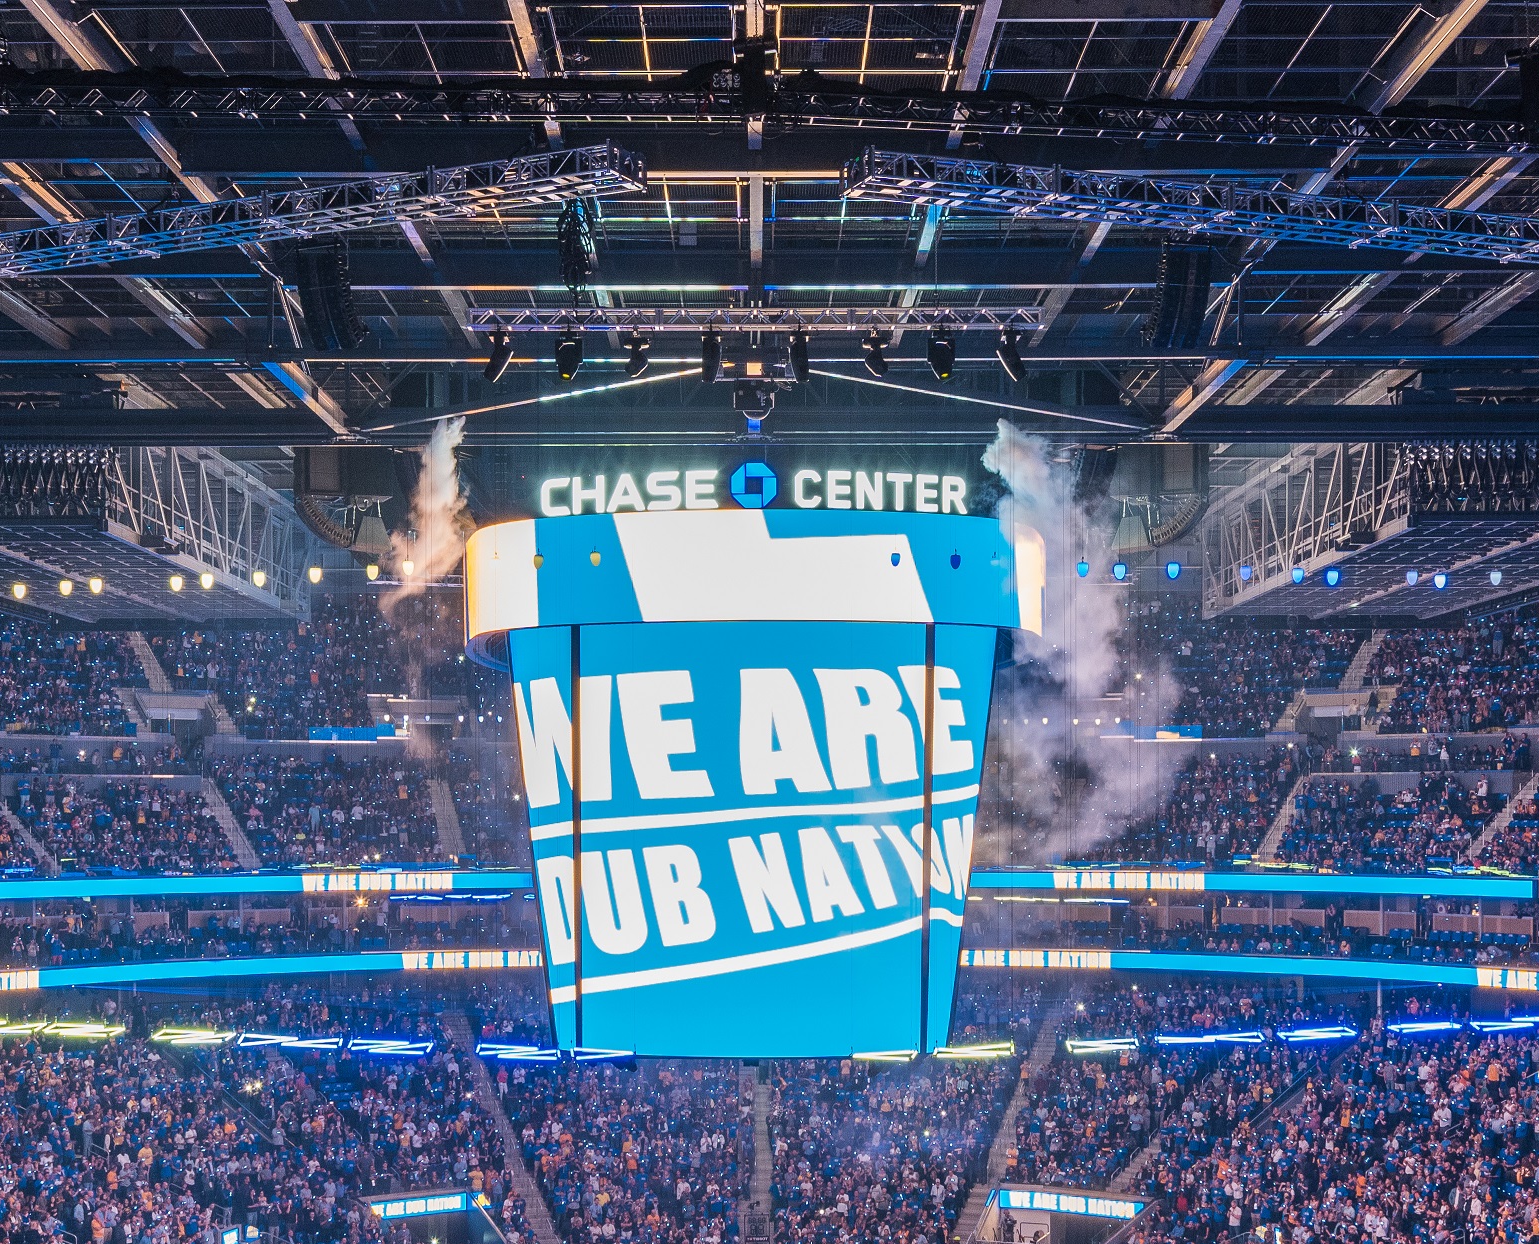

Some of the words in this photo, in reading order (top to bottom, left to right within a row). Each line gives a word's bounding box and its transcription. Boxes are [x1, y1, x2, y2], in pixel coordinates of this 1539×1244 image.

[540, 469, 719, 516] CHASE
[794, 469, 968, 515] CENTER
[513, 670, 715, 809] WE
[739, 665, 975, 796] ARE
[536, 844, 717, 966] DUB
[728, 814, 974, 933] NATION
